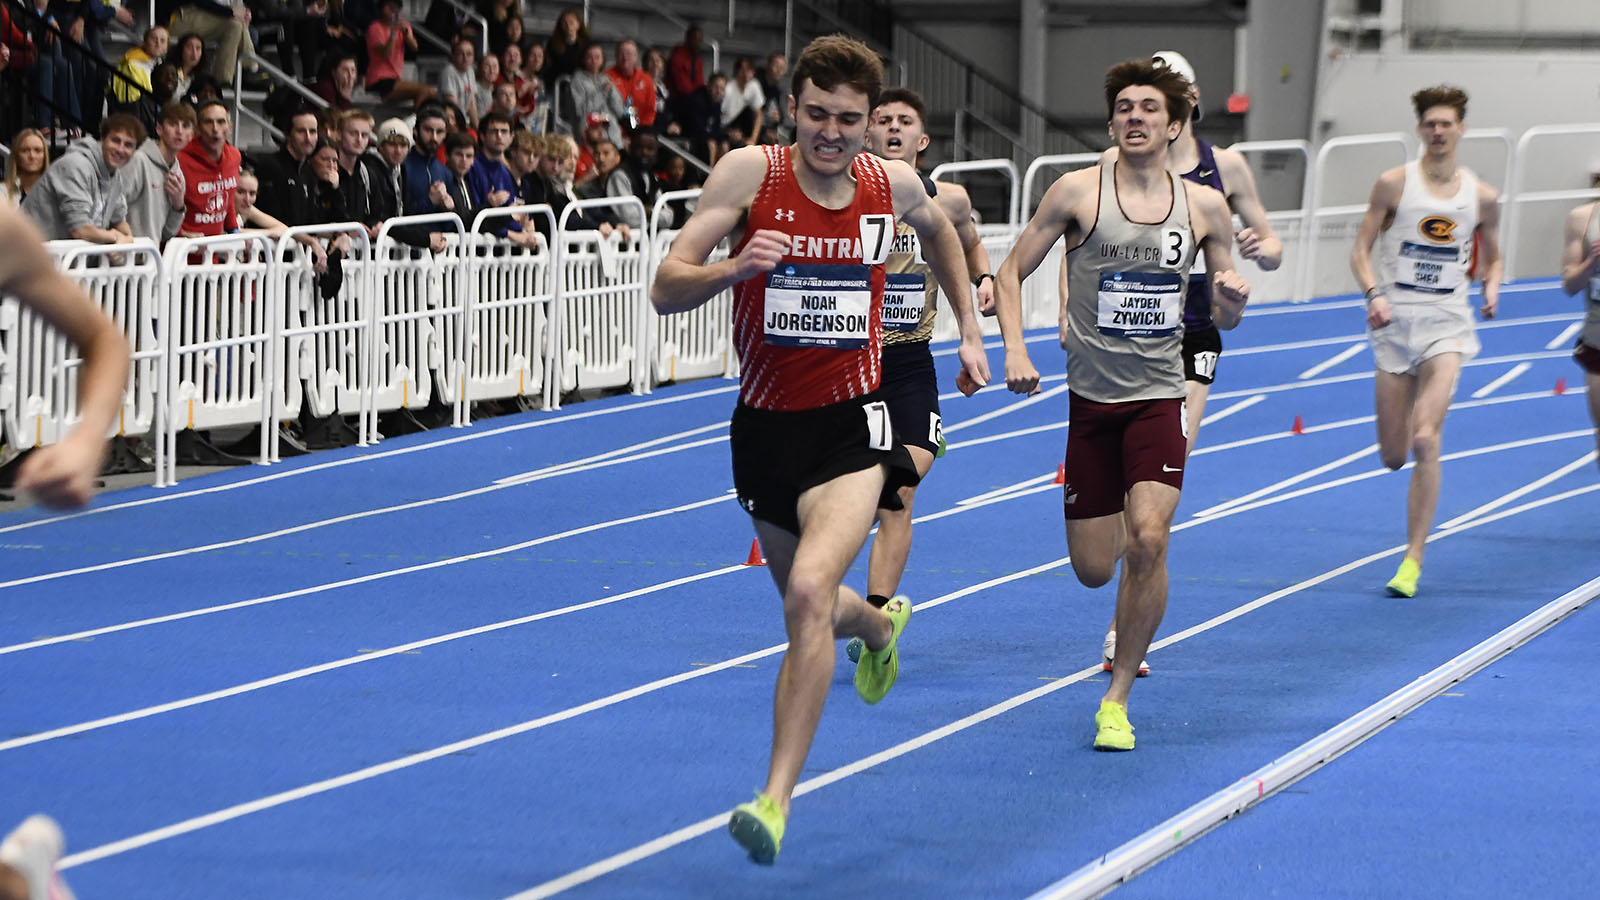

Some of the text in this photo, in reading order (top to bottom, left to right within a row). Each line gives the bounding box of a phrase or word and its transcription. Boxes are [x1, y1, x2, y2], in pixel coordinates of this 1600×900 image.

[781, 235, 863, 259] ENTRA
[866, 217, 886, 261] 7
[1165, 231, 1183, 266] 3
[1101, 243, 1160, 261] UW-LA CR
[801, 295, 837, 310] NOAH
[884, 295, 904, 305] HAN
[1120, 297, 1161, 308] JAYDEN
[767, 312, 867, 333] JORGENSON
[1113, 310, 1166, 325] ZYWICKI
[871, 405, 886, 447] 7
